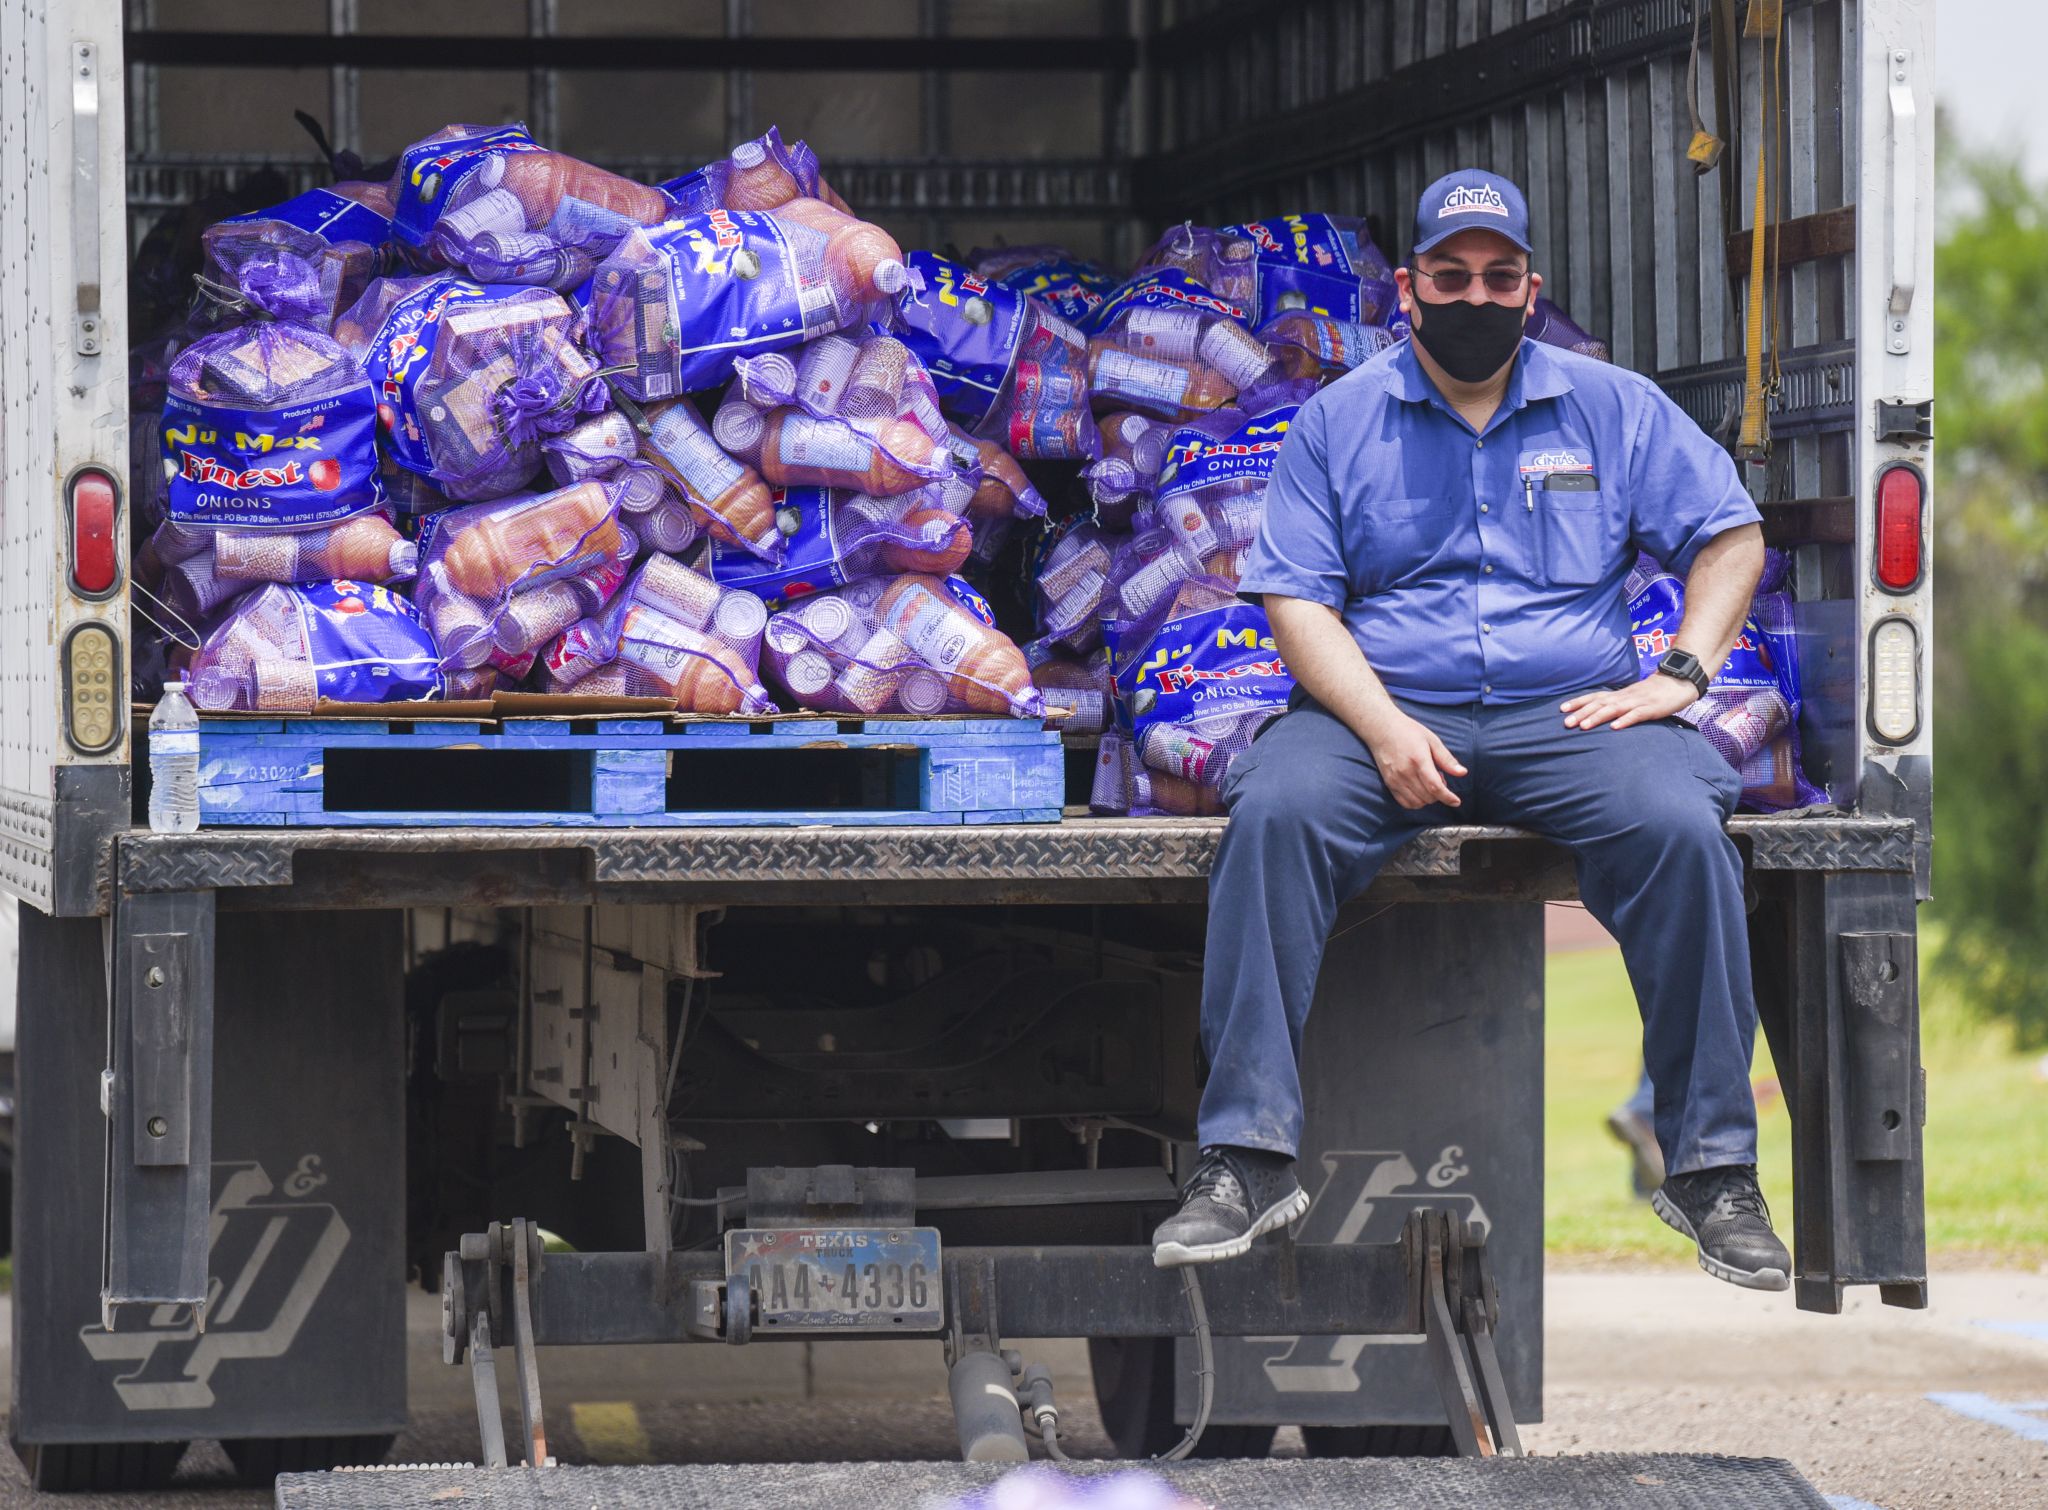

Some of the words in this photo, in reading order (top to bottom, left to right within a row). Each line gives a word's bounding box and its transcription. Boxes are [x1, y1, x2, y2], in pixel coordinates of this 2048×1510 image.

[1446, 185, 1502, 207] CINTAS
[1242, 222, 1284, 253] est
[935, 266, 959, 308] Nu
[283, 409, 311, 419] Produce
[313, 404, 320, 412] of
[166, 424, 216, 449] Nu
[235, 431, 322, 453] Mex
[1207, 458, 1278, 472] ONIONS
[1535, 453, 1577, 466] CINTAS
[180, 450, 304, 491] Finest
[1191, 480, 1206, 488] Chile
[1206, 475, 1221, 483] River
[196, 493, 271, 510] ONIONS
[171, 510, 177, 520] by
[178, 511, 192, 520] Chile
[236, 514, 248, 522] Box
[295, 513, 314, 521] 87941
[1172, 623, 1182, 631] Kg)
[1136, 643, 1193, 684] Nu
[1217, 628, 1278, 650] Me
[1155, 658, 1288, 695] Finest
[1192, 685, 1263, 702] ONIONS
[1193, 708, 1209, 717] River
[1210, 705, 1222, 713] Inc.
[1222, 702, 1232, 711] PO
[1233, 701, 1245, 709] Box
[800, 1233, 869, 1248] TEXAS
[816, 1248, 854, 1258] TRUCK
[840, 1263, 928, 1309] 4336
[799, 1314, 825, 1325] Lone
[829, 1313, 854, 1325] Star
